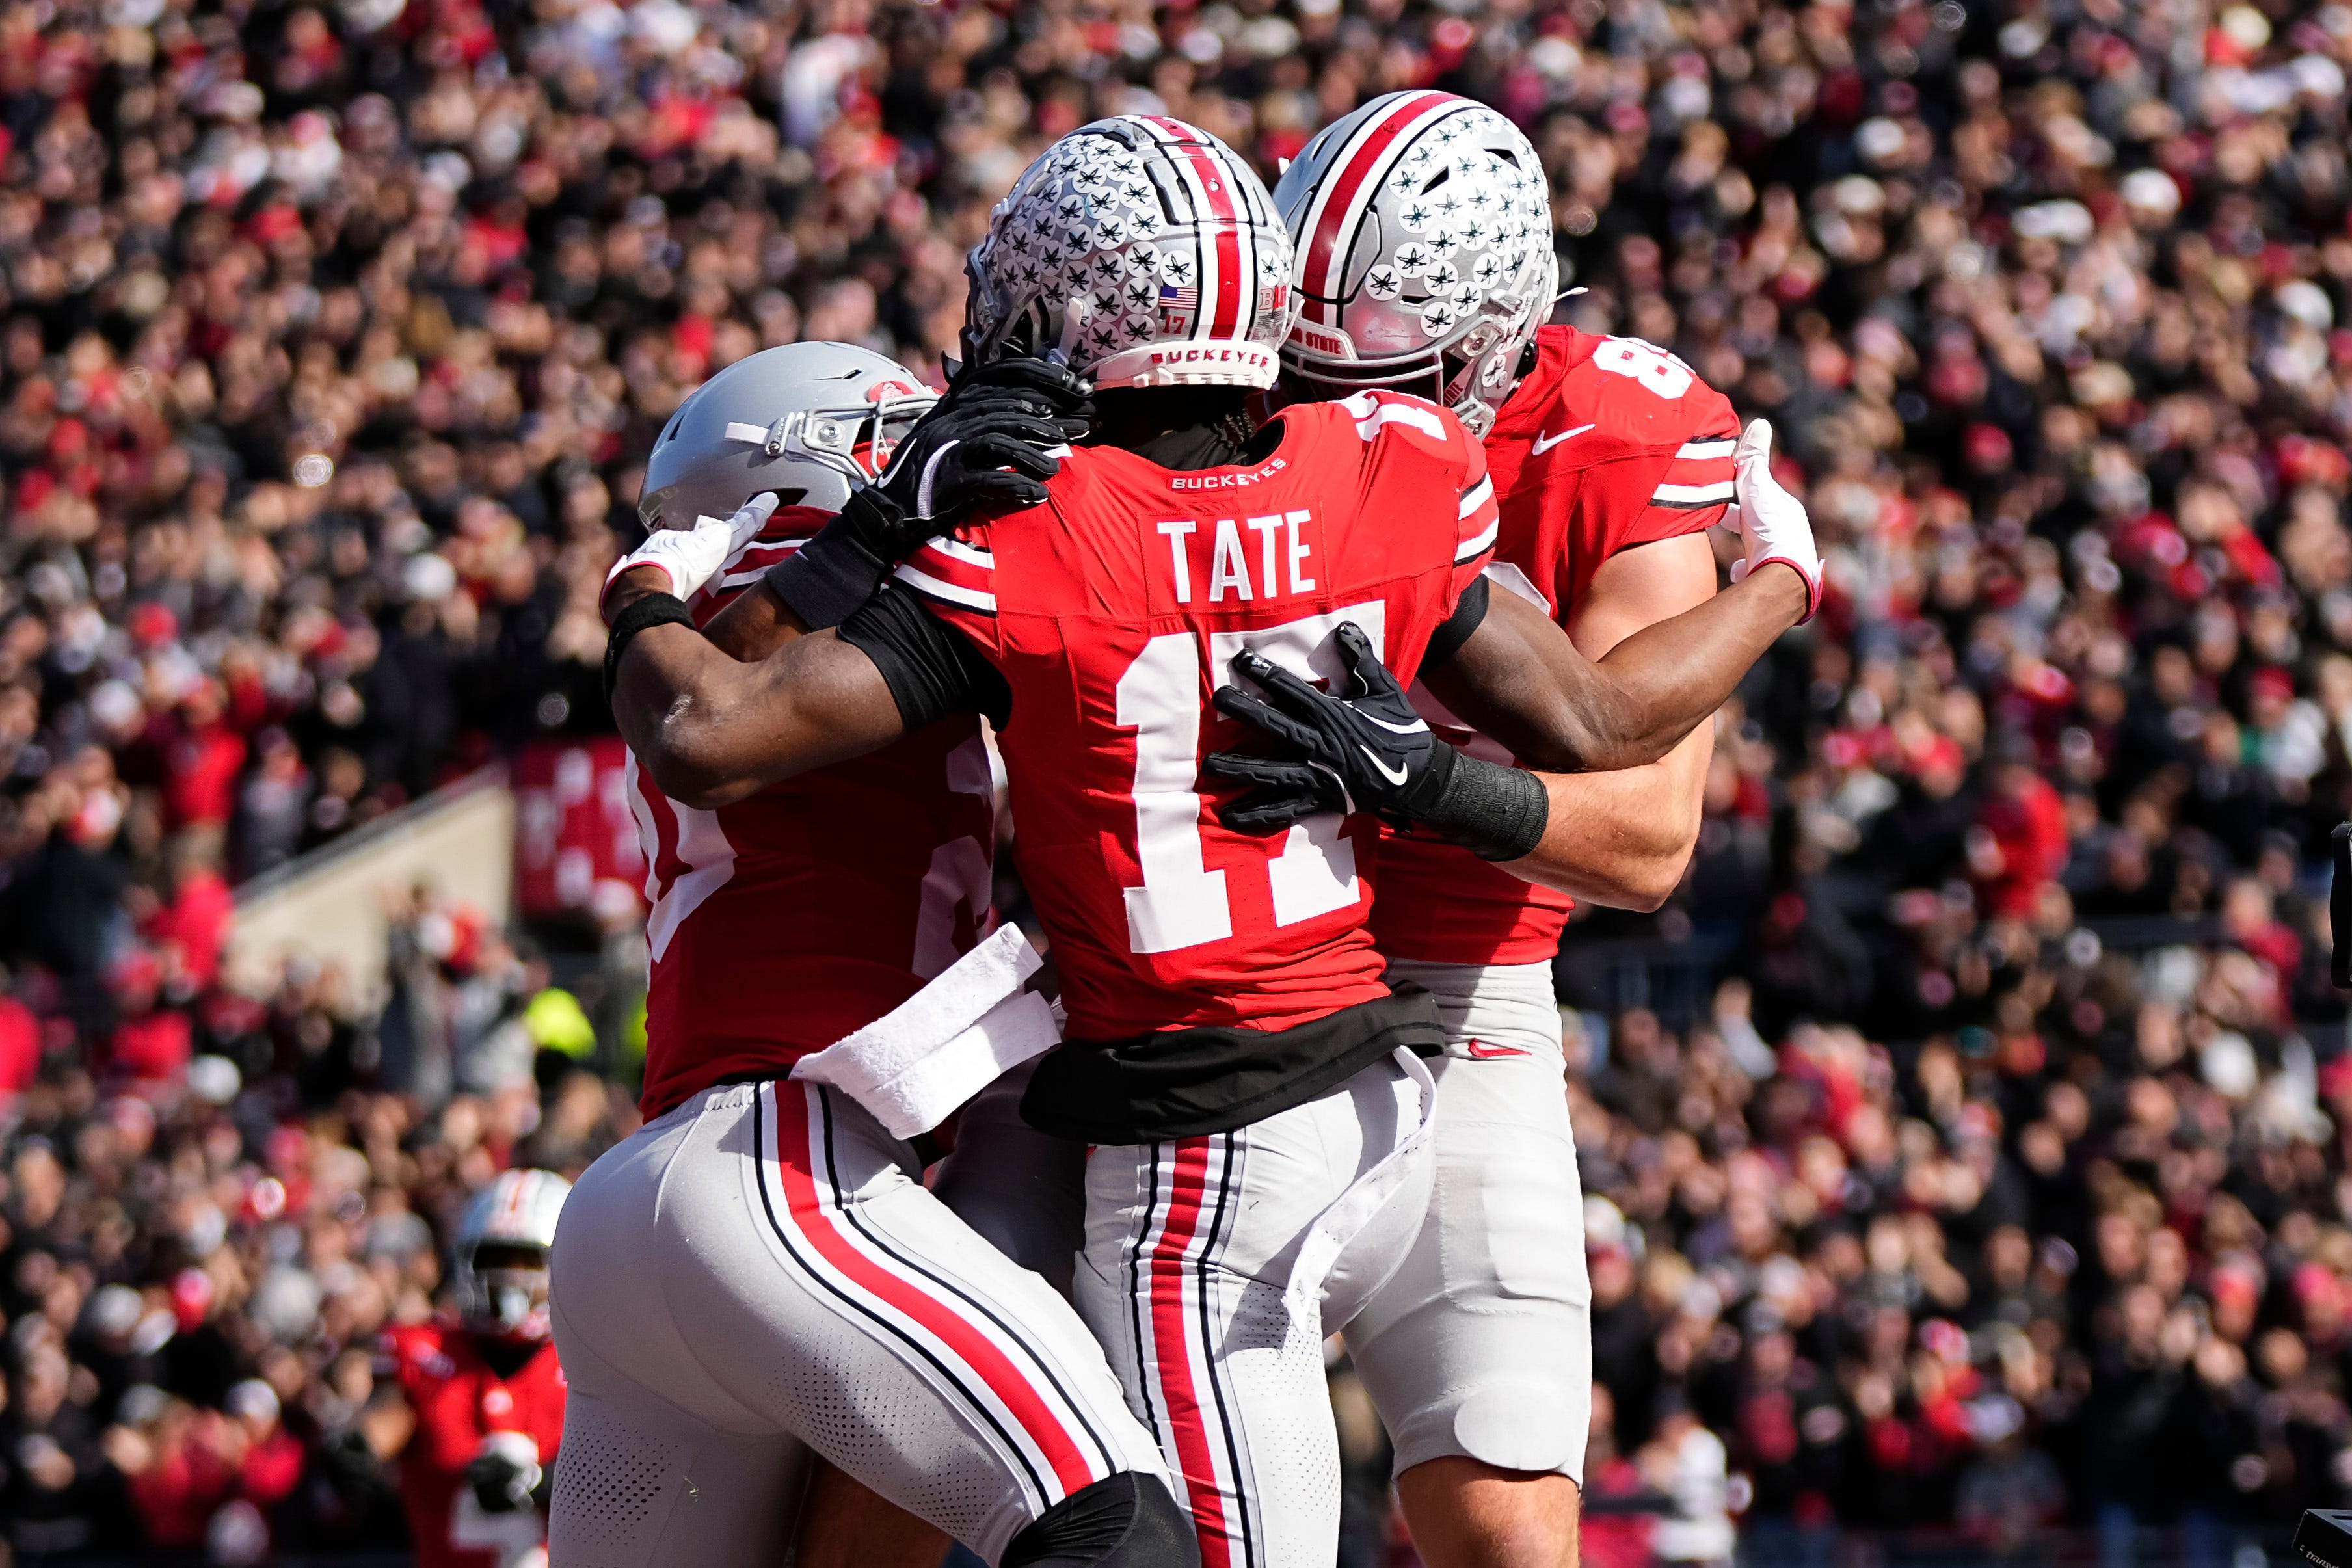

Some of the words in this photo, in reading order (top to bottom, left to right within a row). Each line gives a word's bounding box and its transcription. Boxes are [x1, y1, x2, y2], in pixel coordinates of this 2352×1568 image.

[1162, 315, 1186, 334] 17
[1306, 332, 1341, 354] STATE
[1151, 349, 1268, 367] BUCKEYES
[1172, 458, 1286, 489] BUCKEYES
[1157, 509, 1316, 603] TATE
